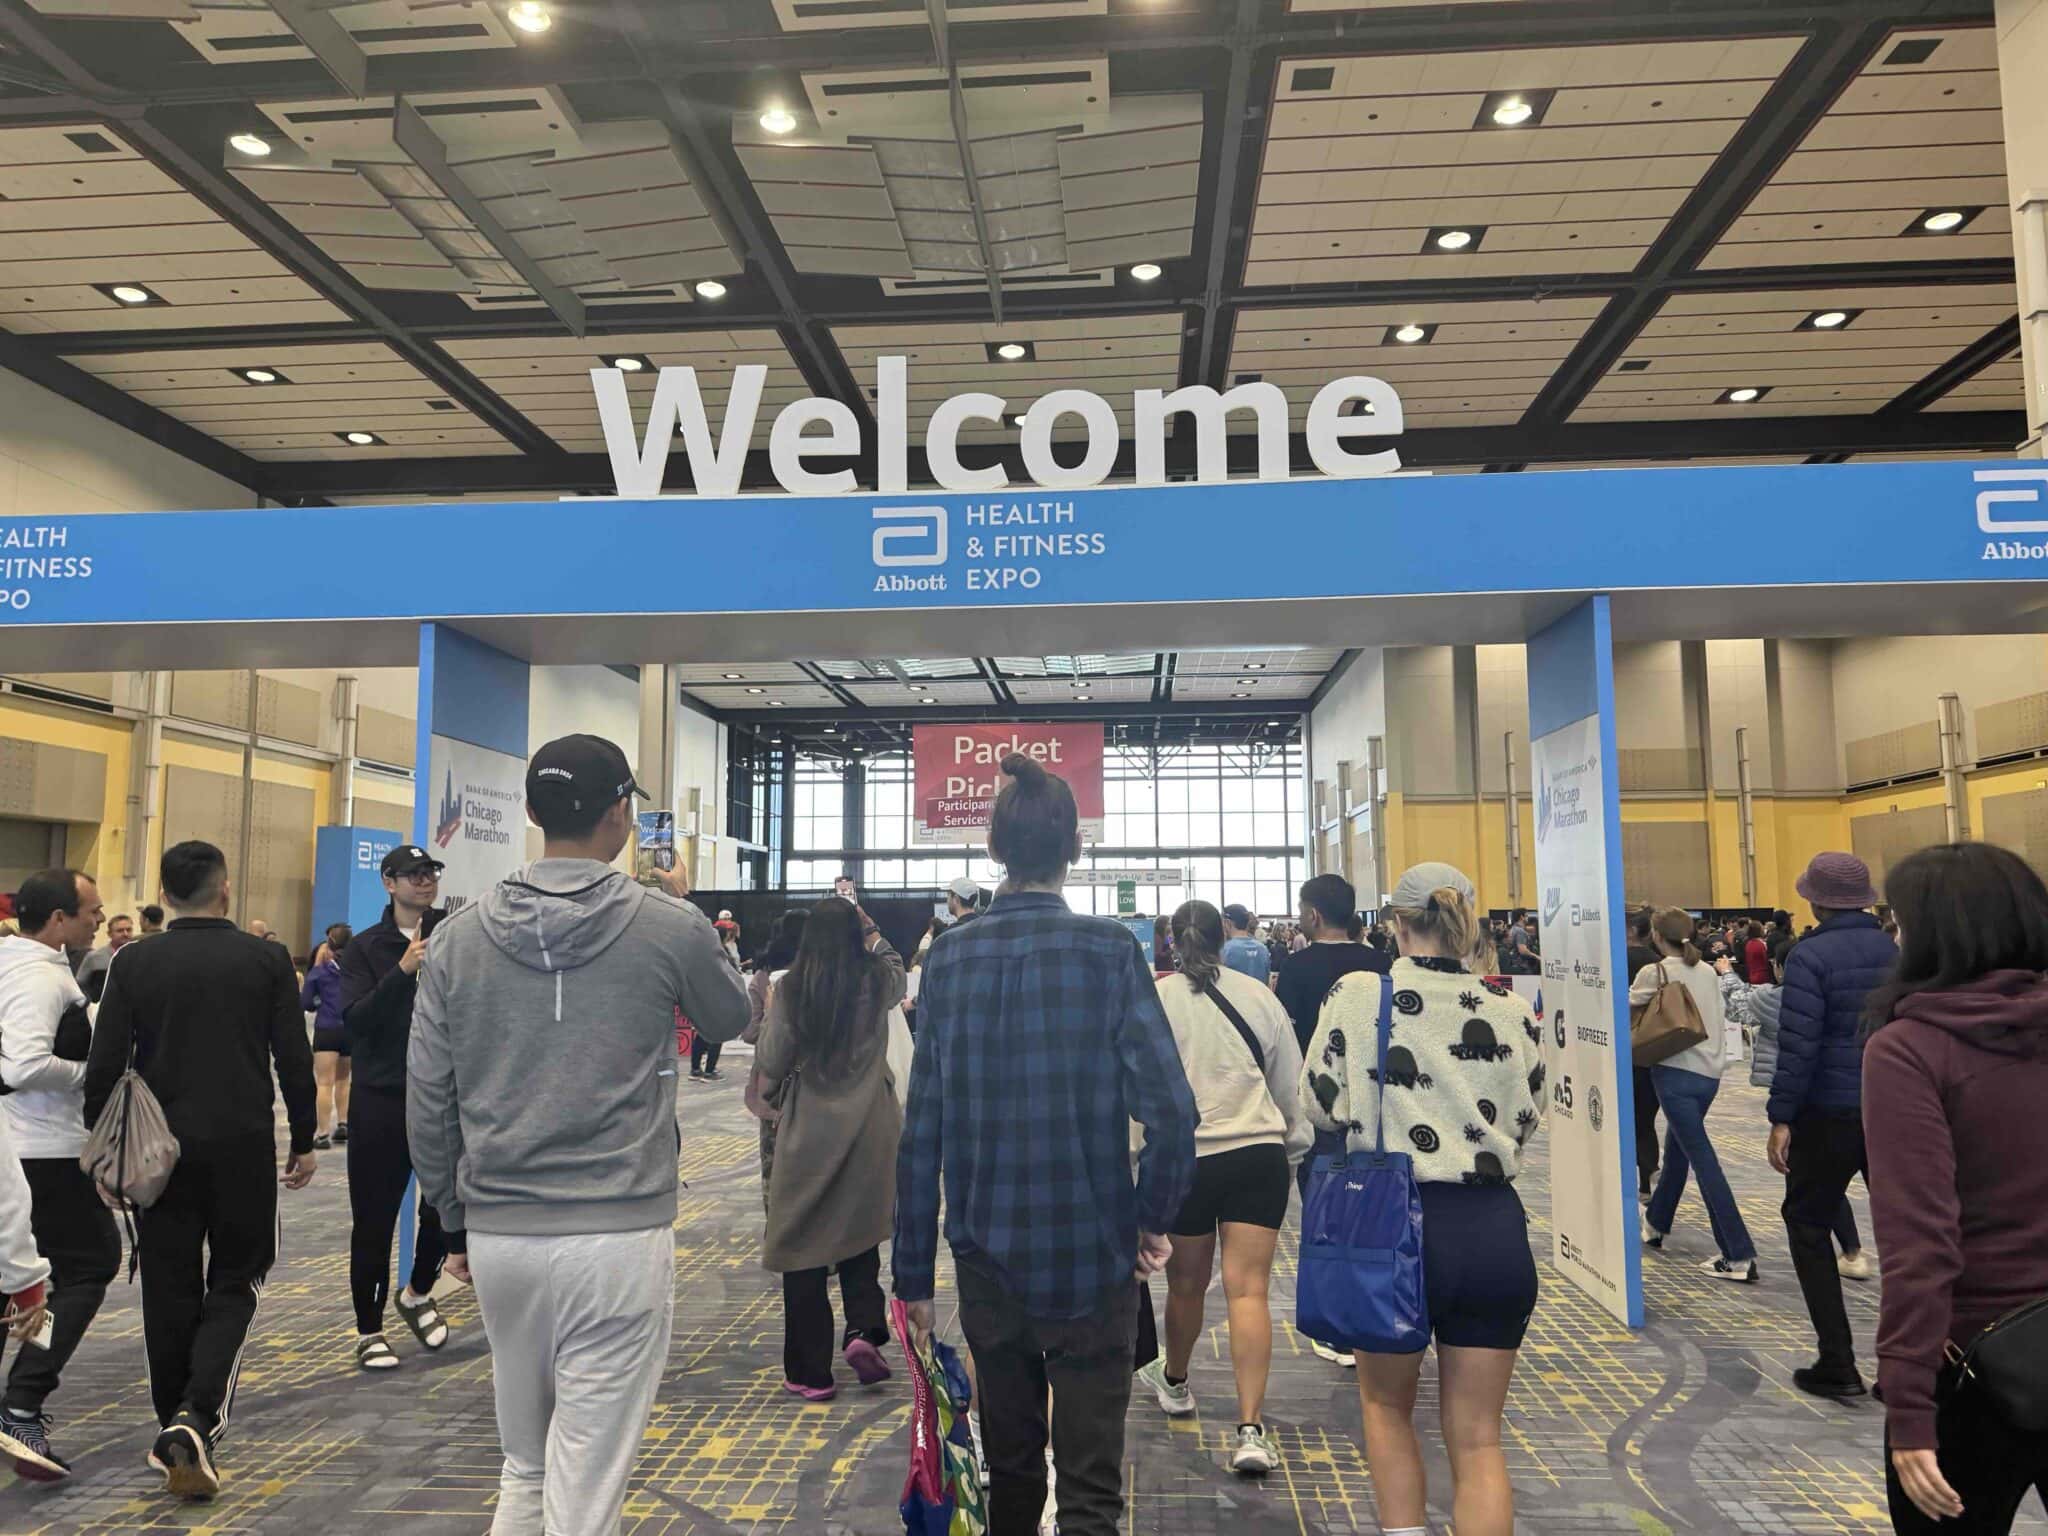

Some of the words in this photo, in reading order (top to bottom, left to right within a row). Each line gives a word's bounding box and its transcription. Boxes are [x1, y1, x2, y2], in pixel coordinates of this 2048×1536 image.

[590, 355, 1404, 498] Welcome
[966, 501, 1074, 526] HEALTH
[966, 536, 984, 558] &
[994, 533, 1106, 557] FITNESS
[872, 573, 948, 592] Abbott
[966, 567, 1041, 590] EXPO
[955, 734, 1063, 764] Packet
[1553, 787, 1580, 807] Chicago
[465, 799, 503, 826] Chicago
[1553, 808, 1588, 828] Marathon
[464, 822, 511, 845] Marathon
[1119, 896, 1135, 904] LOW
[1577, 1025, 1609, 1047] BIOFREEZE
